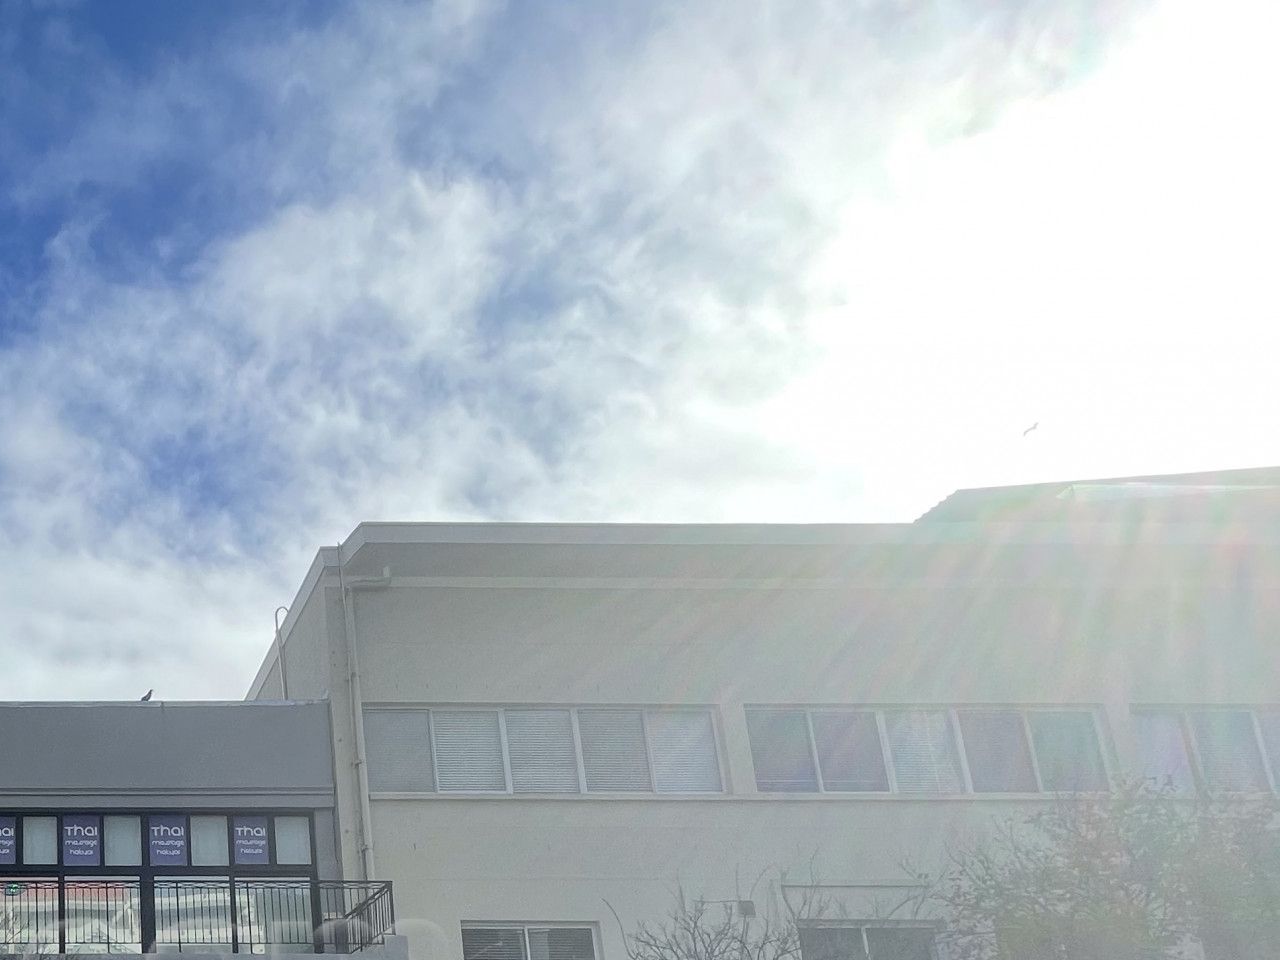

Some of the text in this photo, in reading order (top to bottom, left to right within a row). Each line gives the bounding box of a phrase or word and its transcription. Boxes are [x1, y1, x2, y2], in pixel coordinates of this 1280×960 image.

[64, 824, 98, 836] Thai
[151, 824, 185, 836] Thai
[235, 825, 266, 836] Thai
